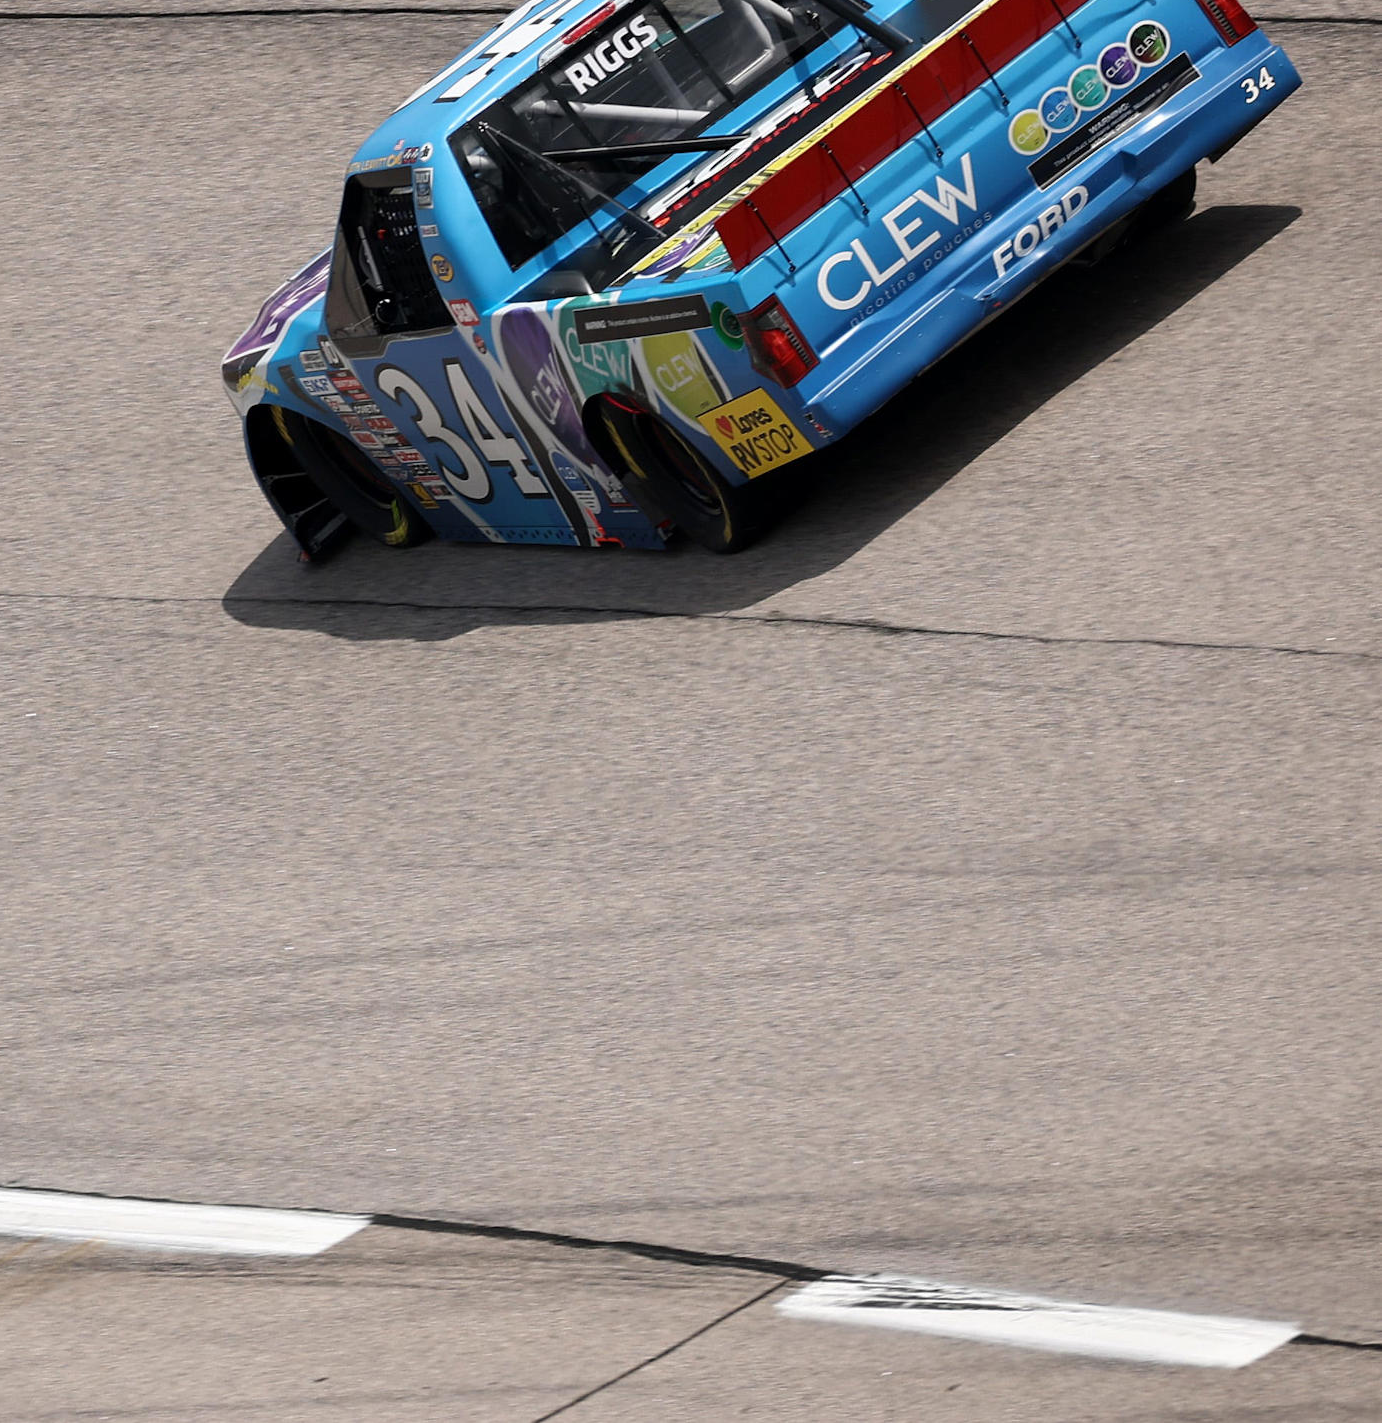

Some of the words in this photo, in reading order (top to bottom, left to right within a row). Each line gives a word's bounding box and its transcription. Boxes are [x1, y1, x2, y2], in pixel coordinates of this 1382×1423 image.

[563, 15, 660, 97] RIGGS
[1134, 29, 1162, 59] CLEW
[1240, 66, 1276, 105] 34
[816, 151, 979, 312] CLEW
[992, 185, 1091, 280] FORD
[849, 271, 917, 328] nicotine
[922, 210, 994, 271] pouches
[302, 378, 329, 393] SKF
[564, 327, 627, 379] CLEW
[656, 344, 704, 392] CLEW
[376, 361, 549, 500] 34
